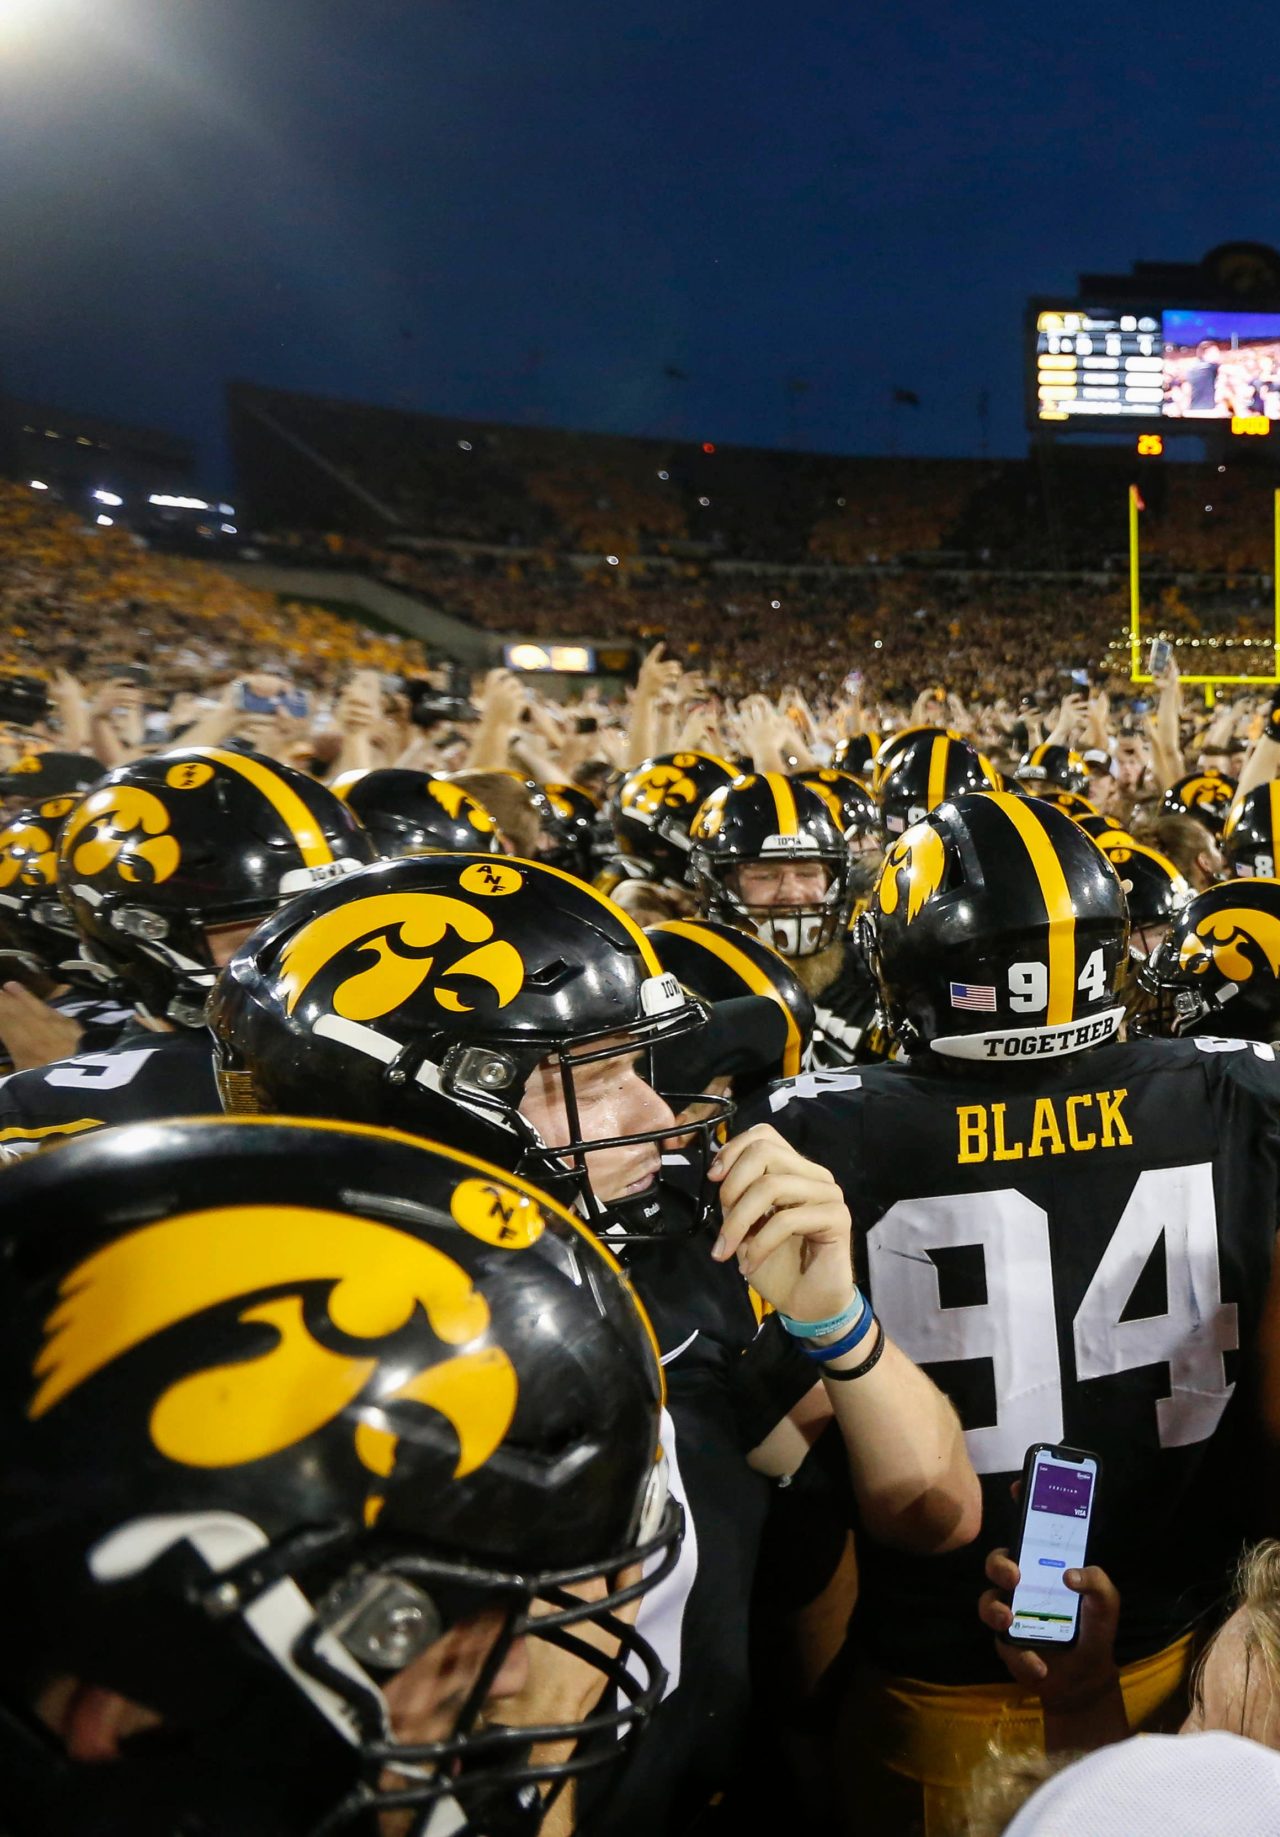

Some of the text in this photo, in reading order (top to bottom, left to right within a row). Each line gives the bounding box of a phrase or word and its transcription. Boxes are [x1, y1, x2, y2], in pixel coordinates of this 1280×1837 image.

[983, 1016, 1114, 1058] TOGETHER
[956, 1088, 1133, 1164] BLACK
[866, 1162, 1239, 1474] 94
